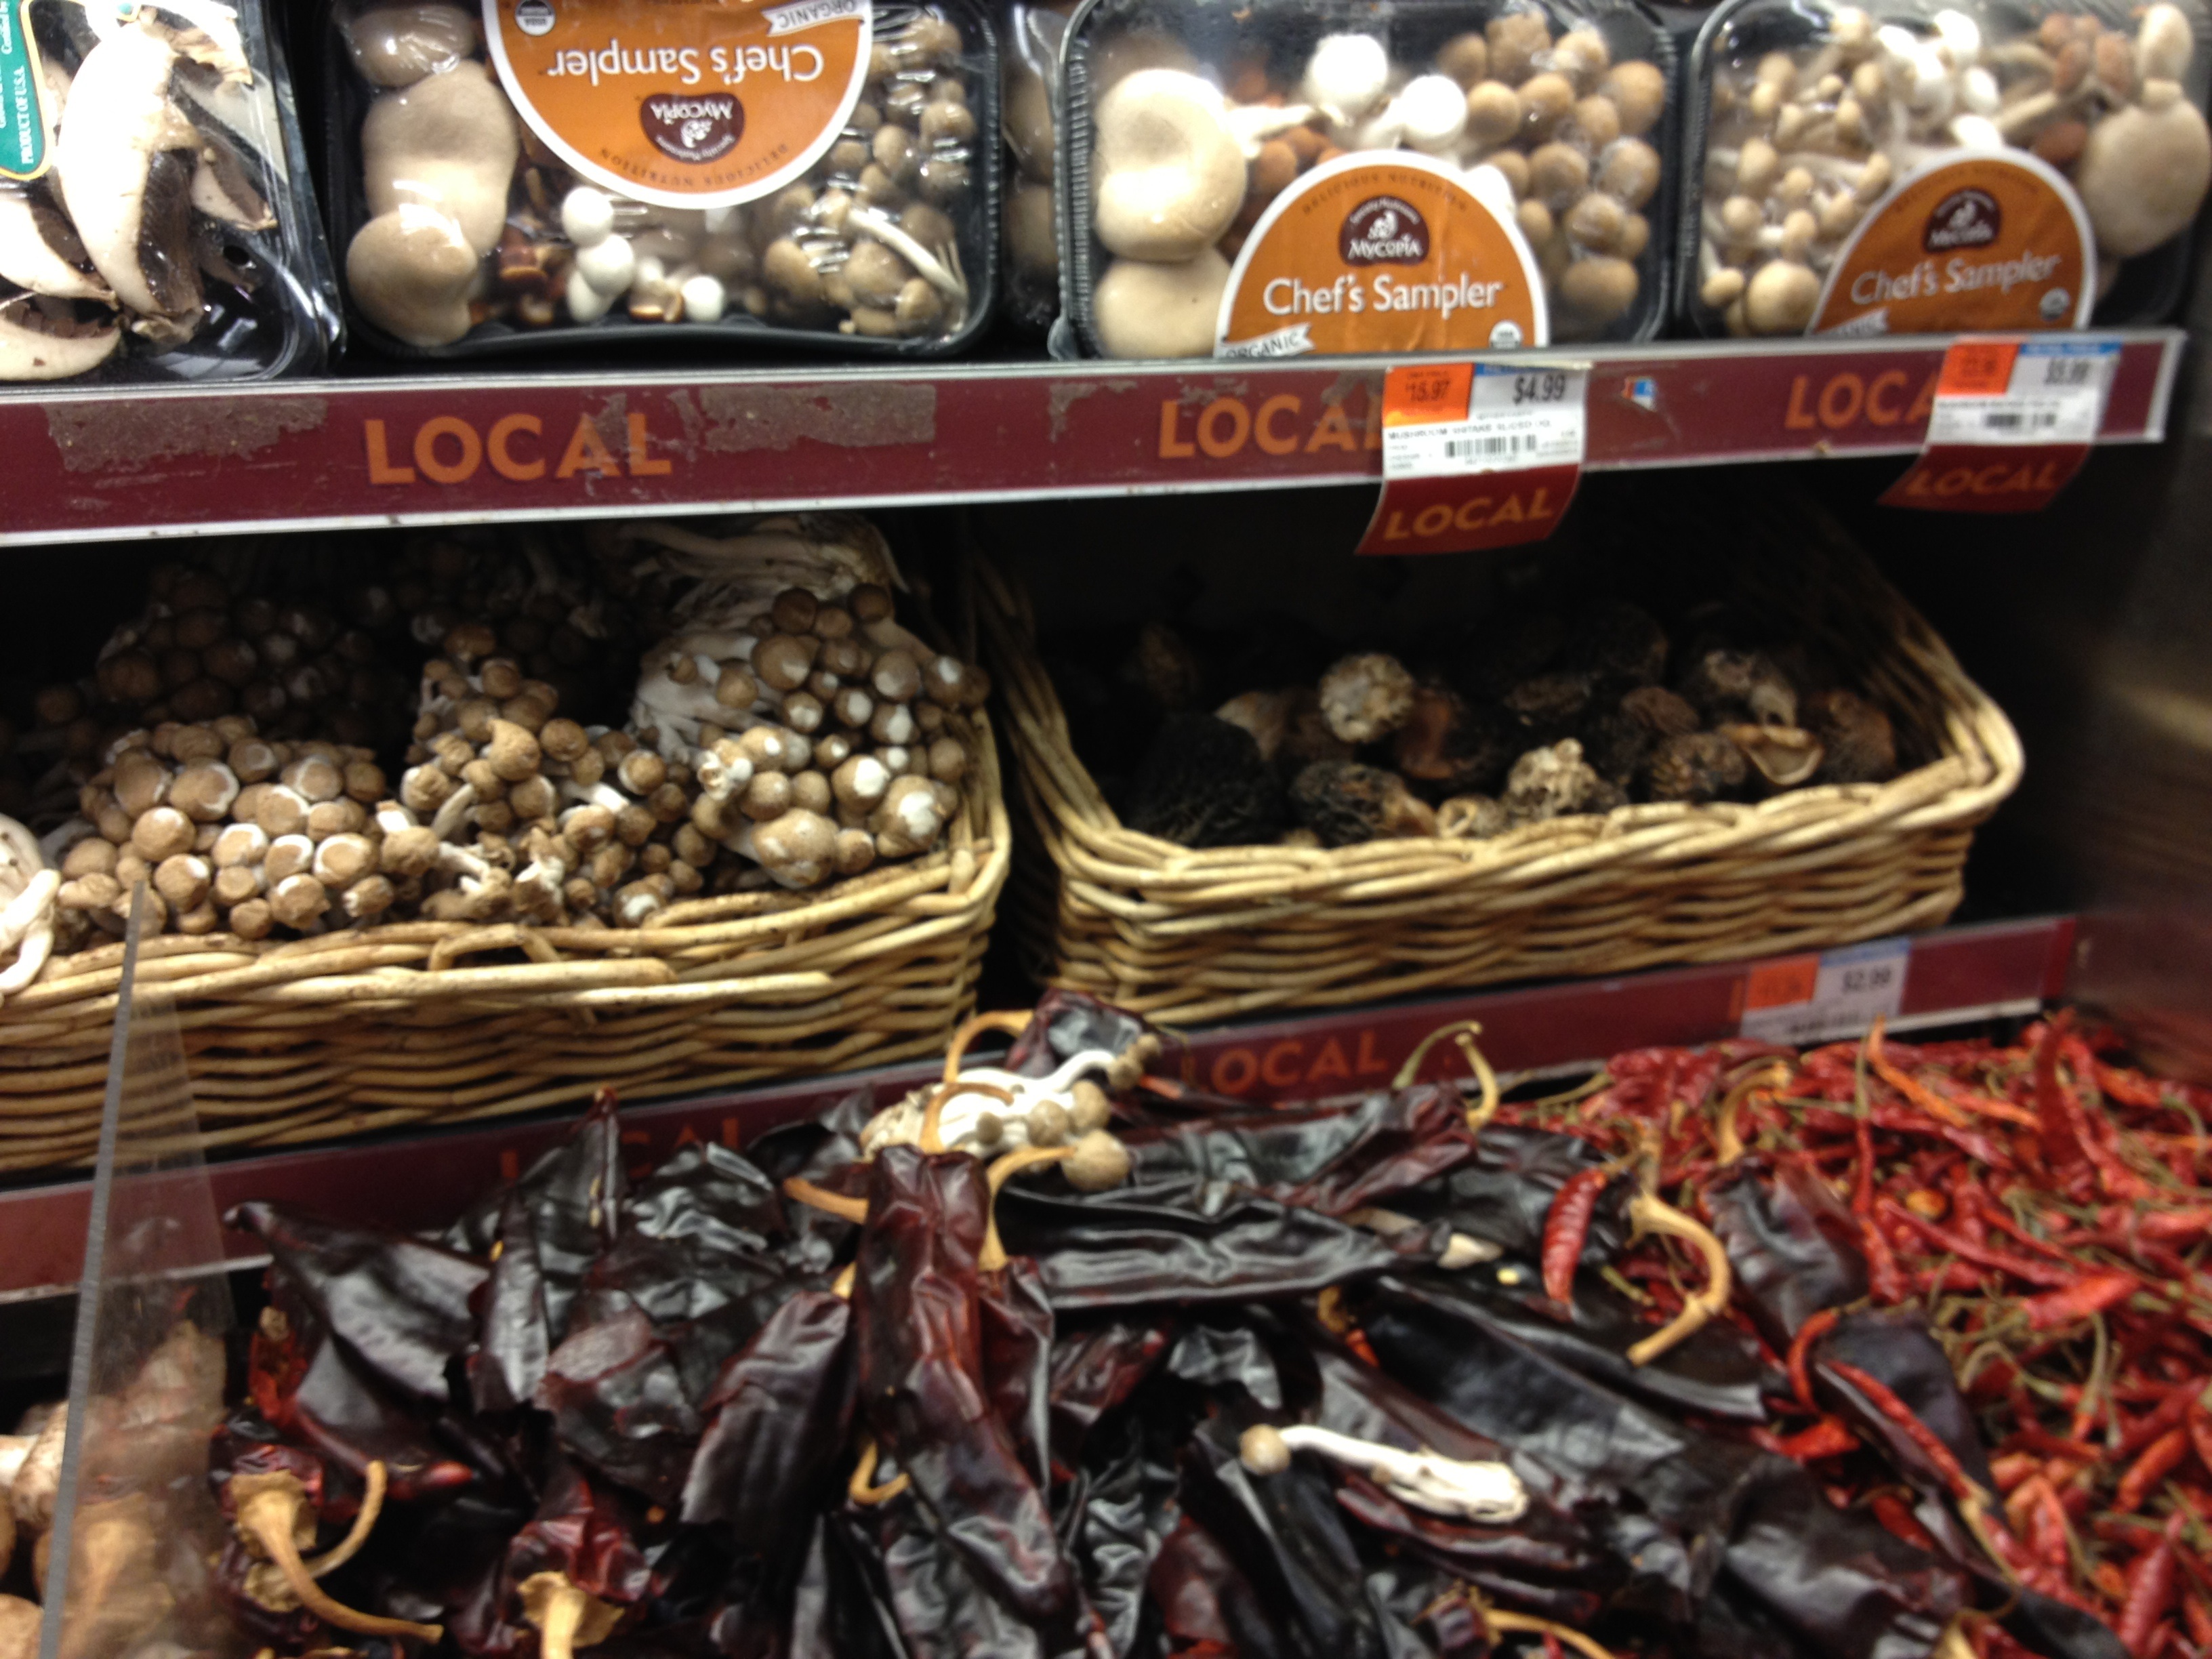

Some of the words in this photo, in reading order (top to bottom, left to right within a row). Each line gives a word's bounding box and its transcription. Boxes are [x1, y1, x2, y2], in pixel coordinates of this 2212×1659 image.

[779, 0, 857, 28] ORGANIC
[547, 39, 701, 86] Sampler
[710, 43, 824, 85] Chef's
[15, 96, 28, 112] OF
[17, 112, 34, 163] PRODUCT
[1263, 274, 1366, 316] Chef's
[1373, 272, 1504, 320] Sampler
[1850, 258, 1938, 306] Chef's
[1943, 251, 2062, 294] Sampler
[1513, 373, 1566, 405] $4.99
[1783, 370, 1938, 429] LOCA
[364, 412, 672, 485] LOCAL
[1904, 462, 2059, 497] LOCAL
[1382, 487, 1553, 541] LOCAL
